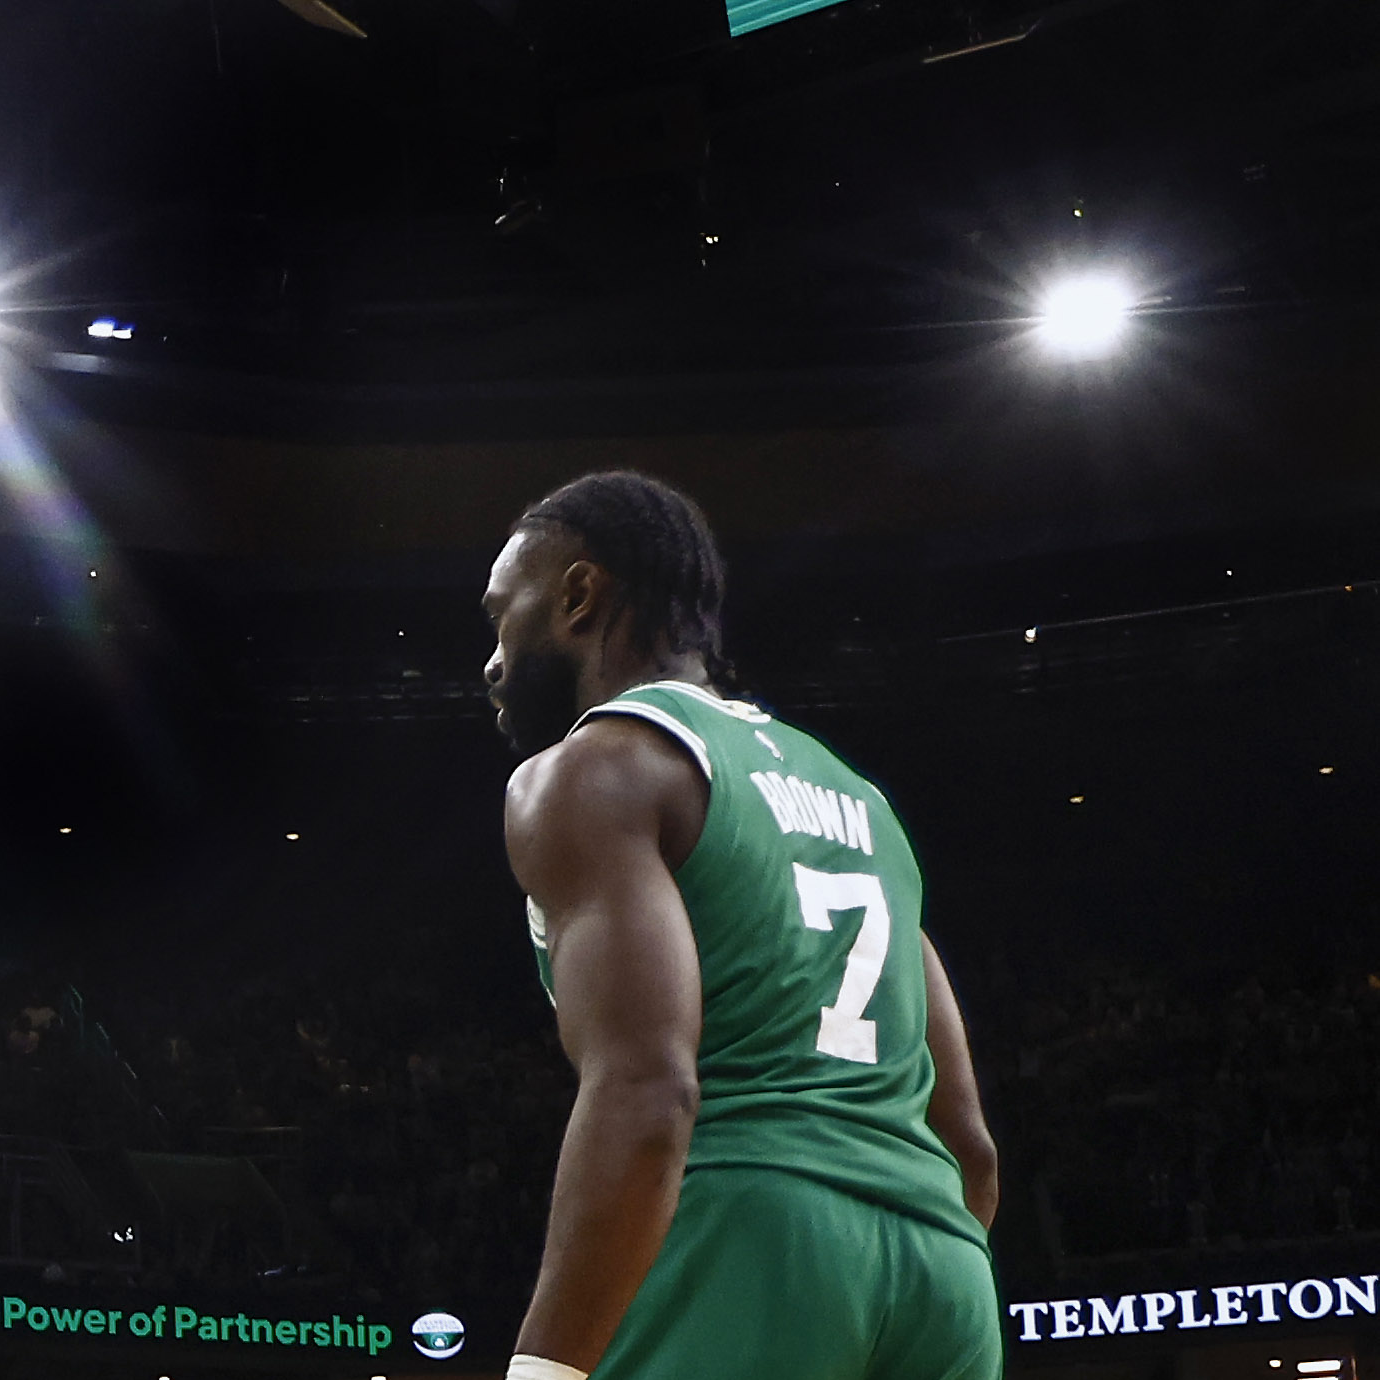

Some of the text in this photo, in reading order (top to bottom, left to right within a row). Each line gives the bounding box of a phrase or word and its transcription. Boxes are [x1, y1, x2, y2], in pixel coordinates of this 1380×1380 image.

[792, 861, 890, 1065] 7
[3, 1296, 122, 1336] Power
[129, 1304, 166, 1338] of
[175, 1306, 392, 1355] Partnership
[1008, 1274, 1380, 1342] TEMPLETON
